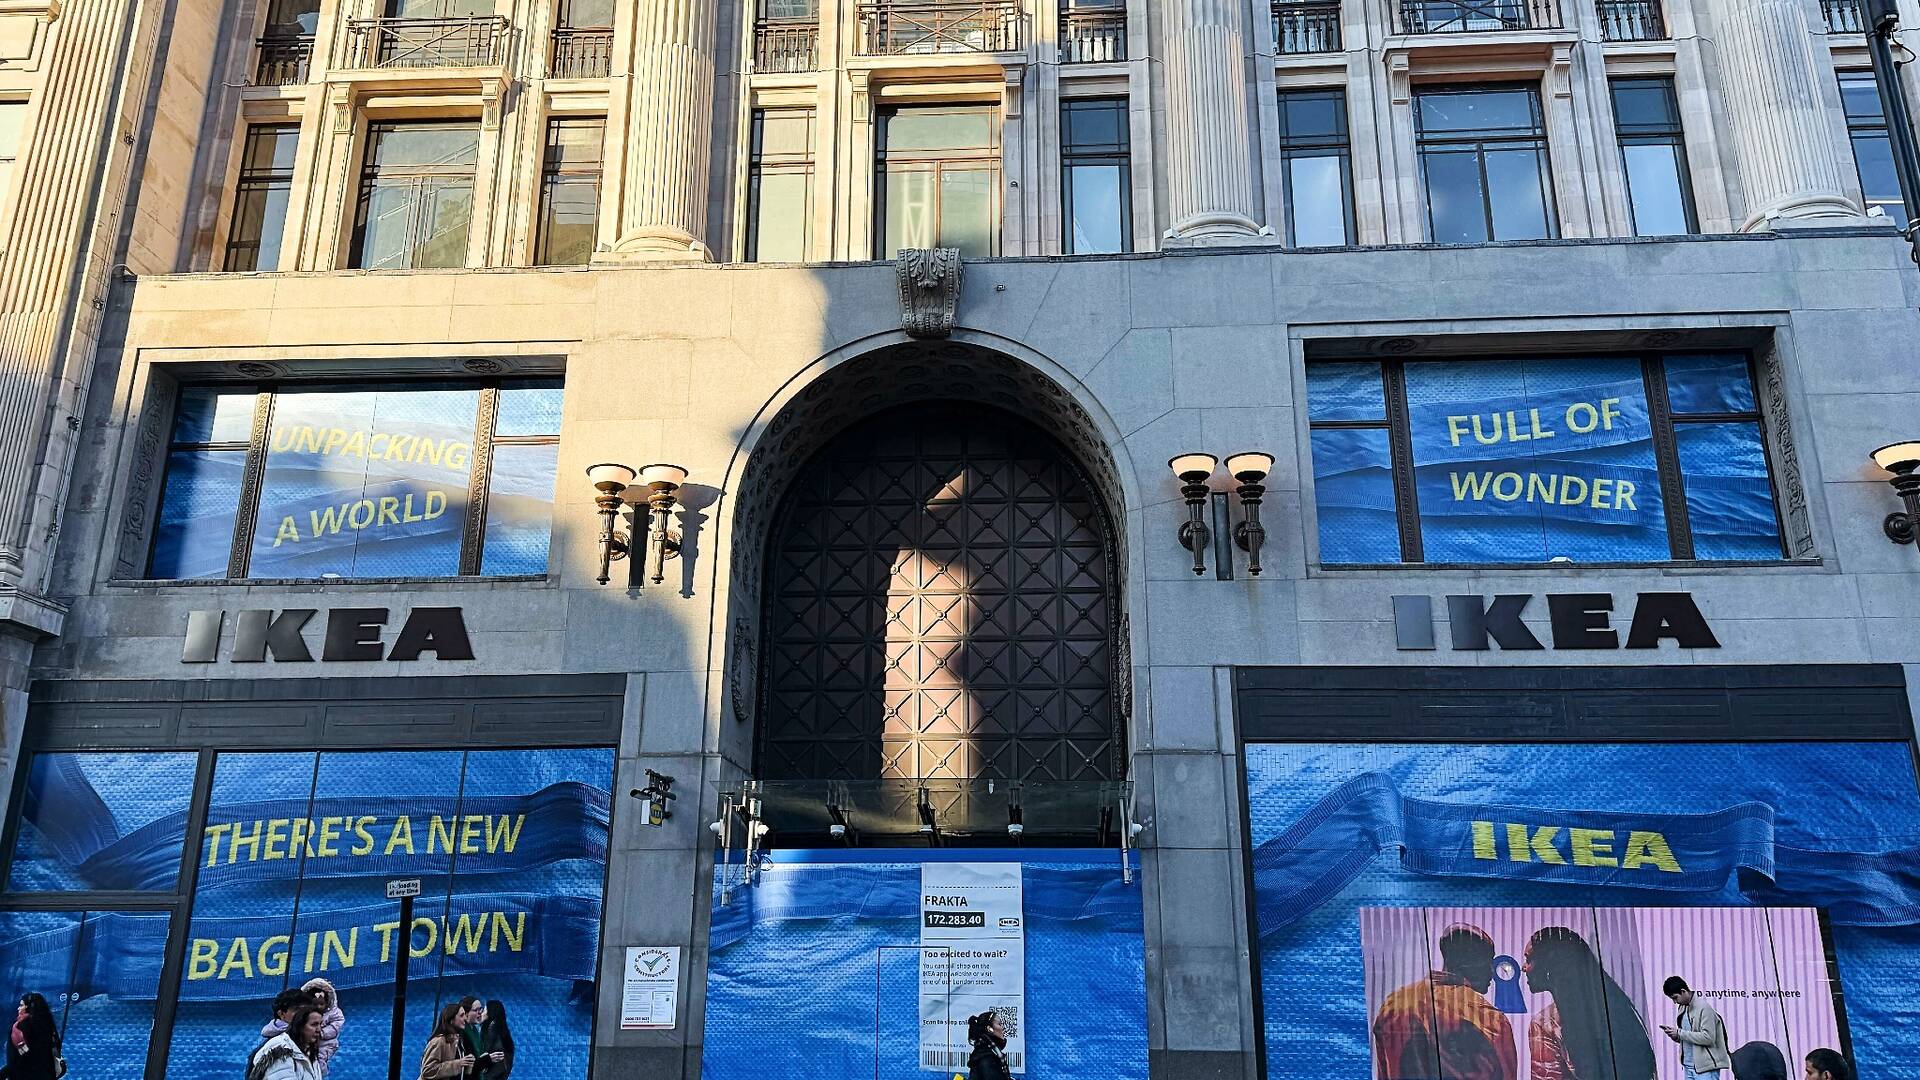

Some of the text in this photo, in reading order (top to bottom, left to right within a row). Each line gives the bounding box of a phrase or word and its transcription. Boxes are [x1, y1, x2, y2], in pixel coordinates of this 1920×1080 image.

[1448, 398, 1621, 446] FULL OF
[271, 426, 470, 470] UNPACKING
[1450, 471, 1638, 511] WONDER
[272, 490, 448, 547] A WORLD
[181, 607, 476, 663] IKEA
[1391, 592, 1722, 651] IKEA
[204, 814, 526, 867] THERE'S A NEW
[1471, 821, 1683, 873] IKEA
[924, 895, 968, 907] FRAKTA
[927, 912, 982, 926] 172.283.40
[1000, 918, 1018, 926] IKEA
[187, 912, 526, 981] BAG IN TOWN
[924, 950, 938, 958] Too
[940, 950, 970, 958] excited
[984, 950, 1007, 958] wait?
[1705, 989, 1750, 999] anytime,
[1752, 989, 1801, 999] anywhere
